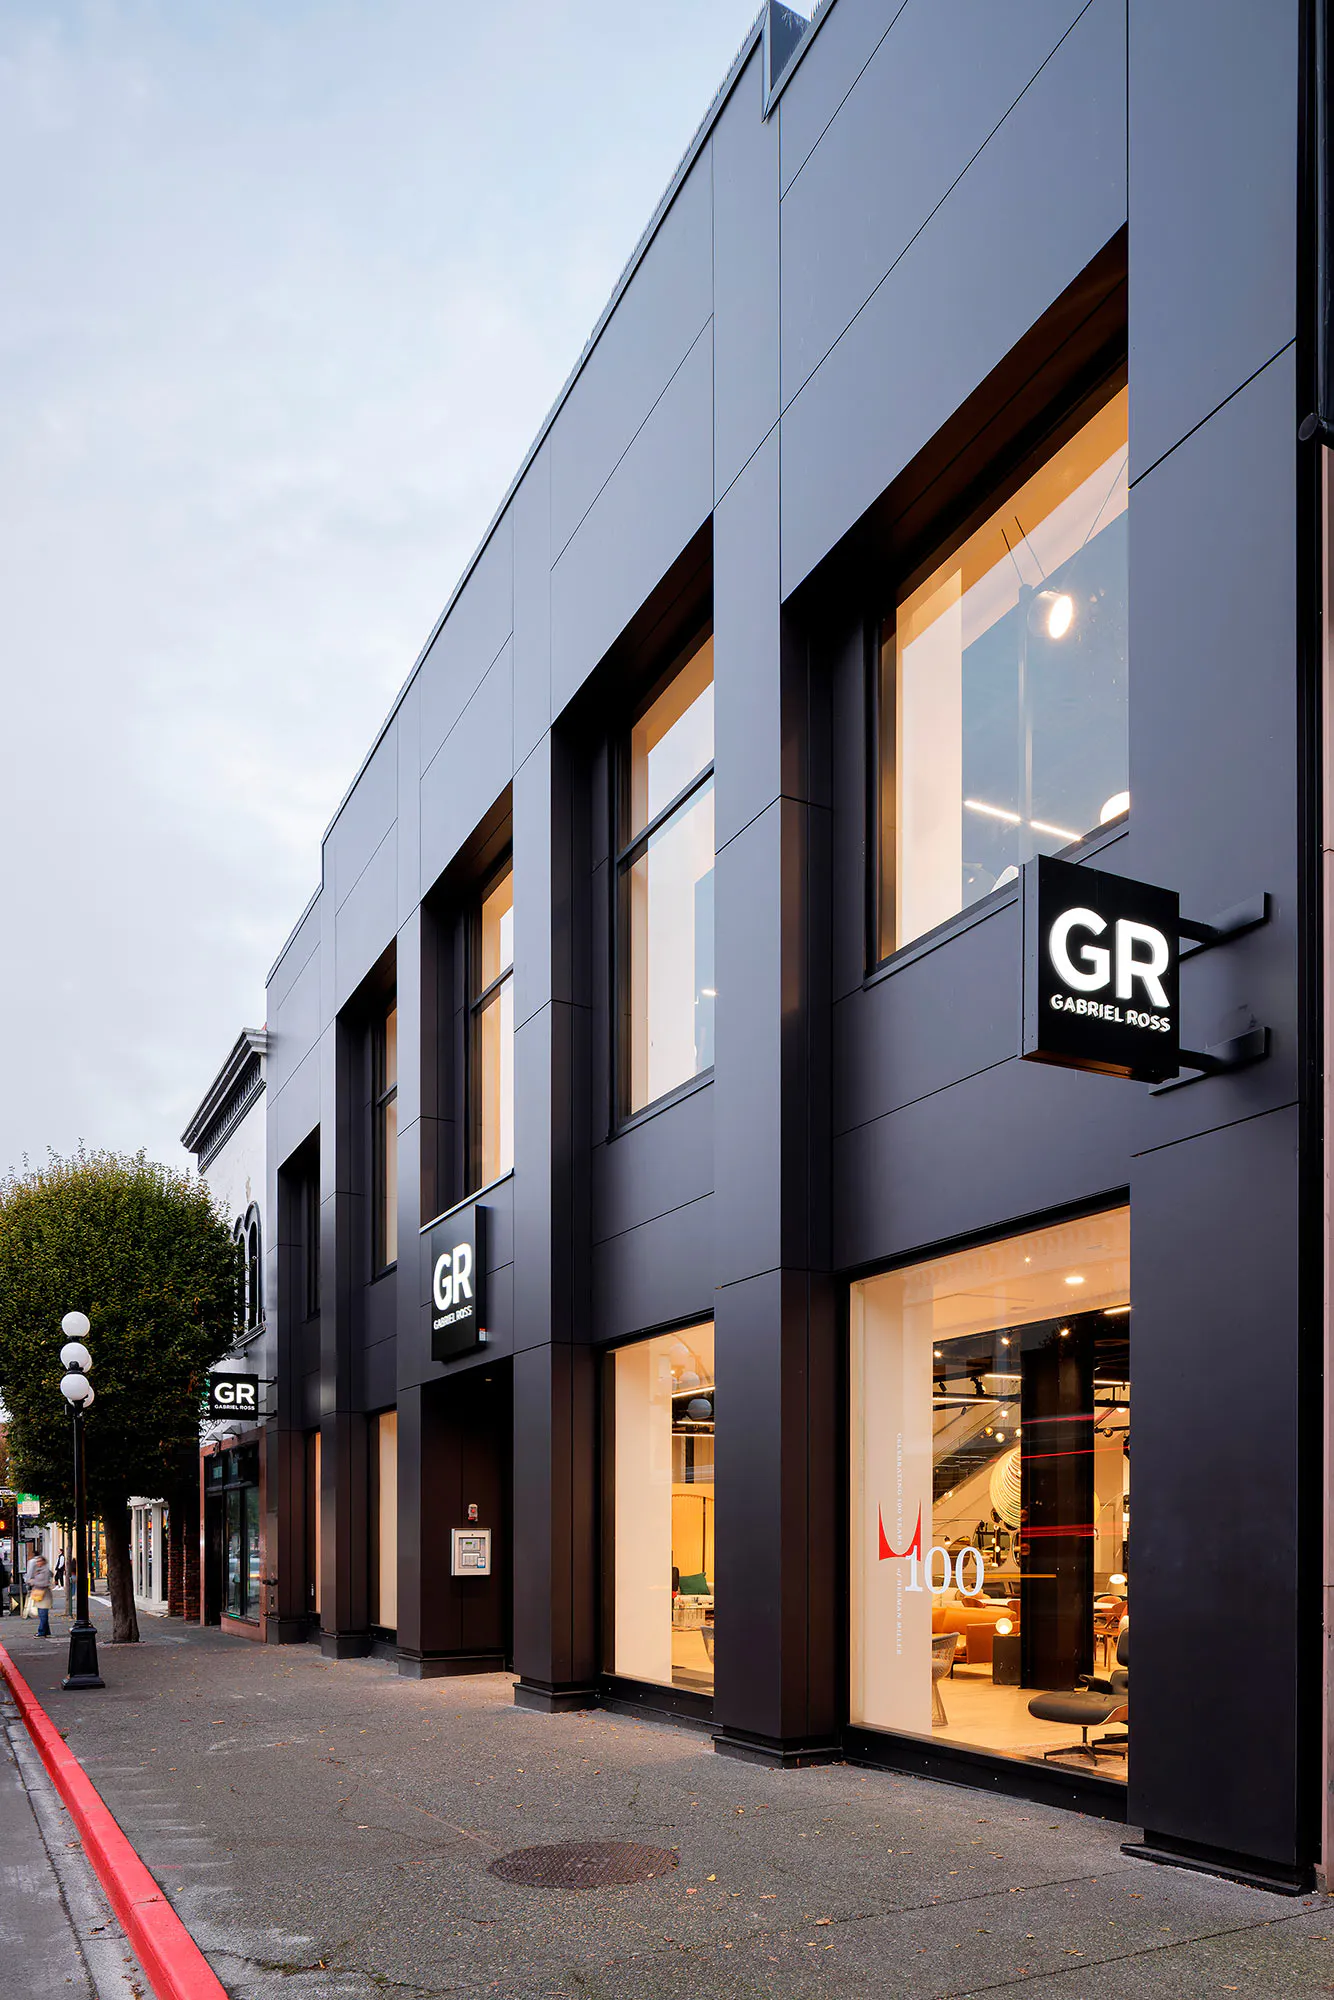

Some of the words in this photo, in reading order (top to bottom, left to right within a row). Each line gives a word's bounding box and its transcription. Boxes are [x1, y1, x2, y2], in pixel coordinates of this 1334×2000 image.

[1048, 907, 1172, 1009] GR
[1050, 993, 1125, 1023] GABRIEL
[1126, 1009, 1172, 1033] ROSS
[433, 1242, 473, 1311] GR
[433, 1312, 456, 1330] GABRIEL
[456, 1305, 473, 1321] ROSS
[214, 1382, 255, 1404] GR
[904, 1544, 985, 1597] 100
